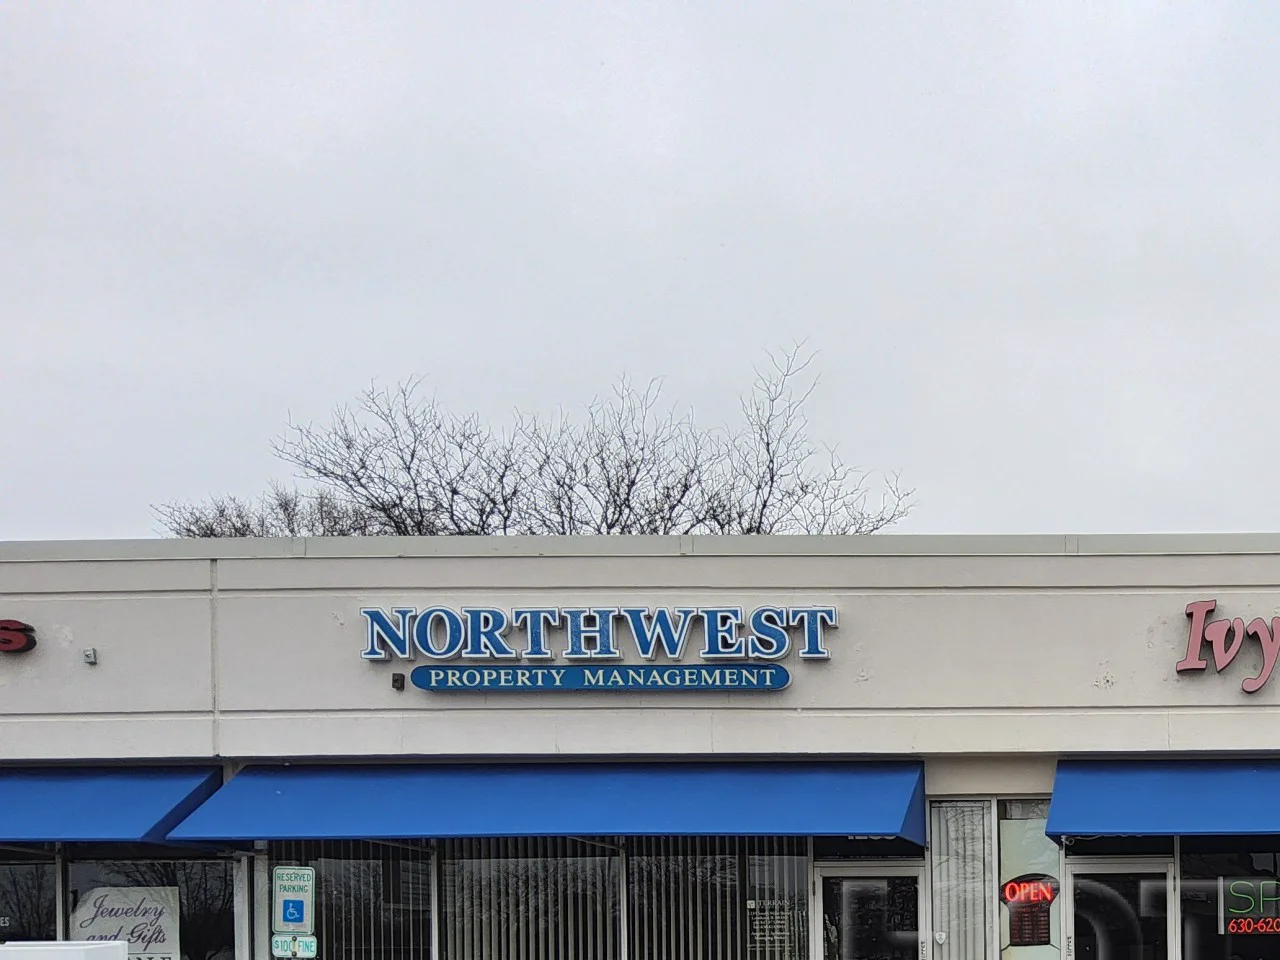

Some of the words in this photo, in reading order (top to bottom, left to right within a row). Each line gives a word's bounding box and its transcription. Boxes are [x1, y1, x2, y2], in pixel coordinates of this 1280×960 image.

[360, 605, 838, 661] NORTHWEST
[429, 669, 566, 687] PROPERTY
[583, 667, 776, 687] MANAGEMENT
[276, 872, 312, 882] RESERVED
[279, 884, 308, 894] PARKING
[1005, 881, 1052, 902] OPEN
[79, 893, 167, 929] Jewelry
[86, 925, 124, 942] and
[126, 922, 168, 951] Gifts
[297, 940, 316, 953] FINE
